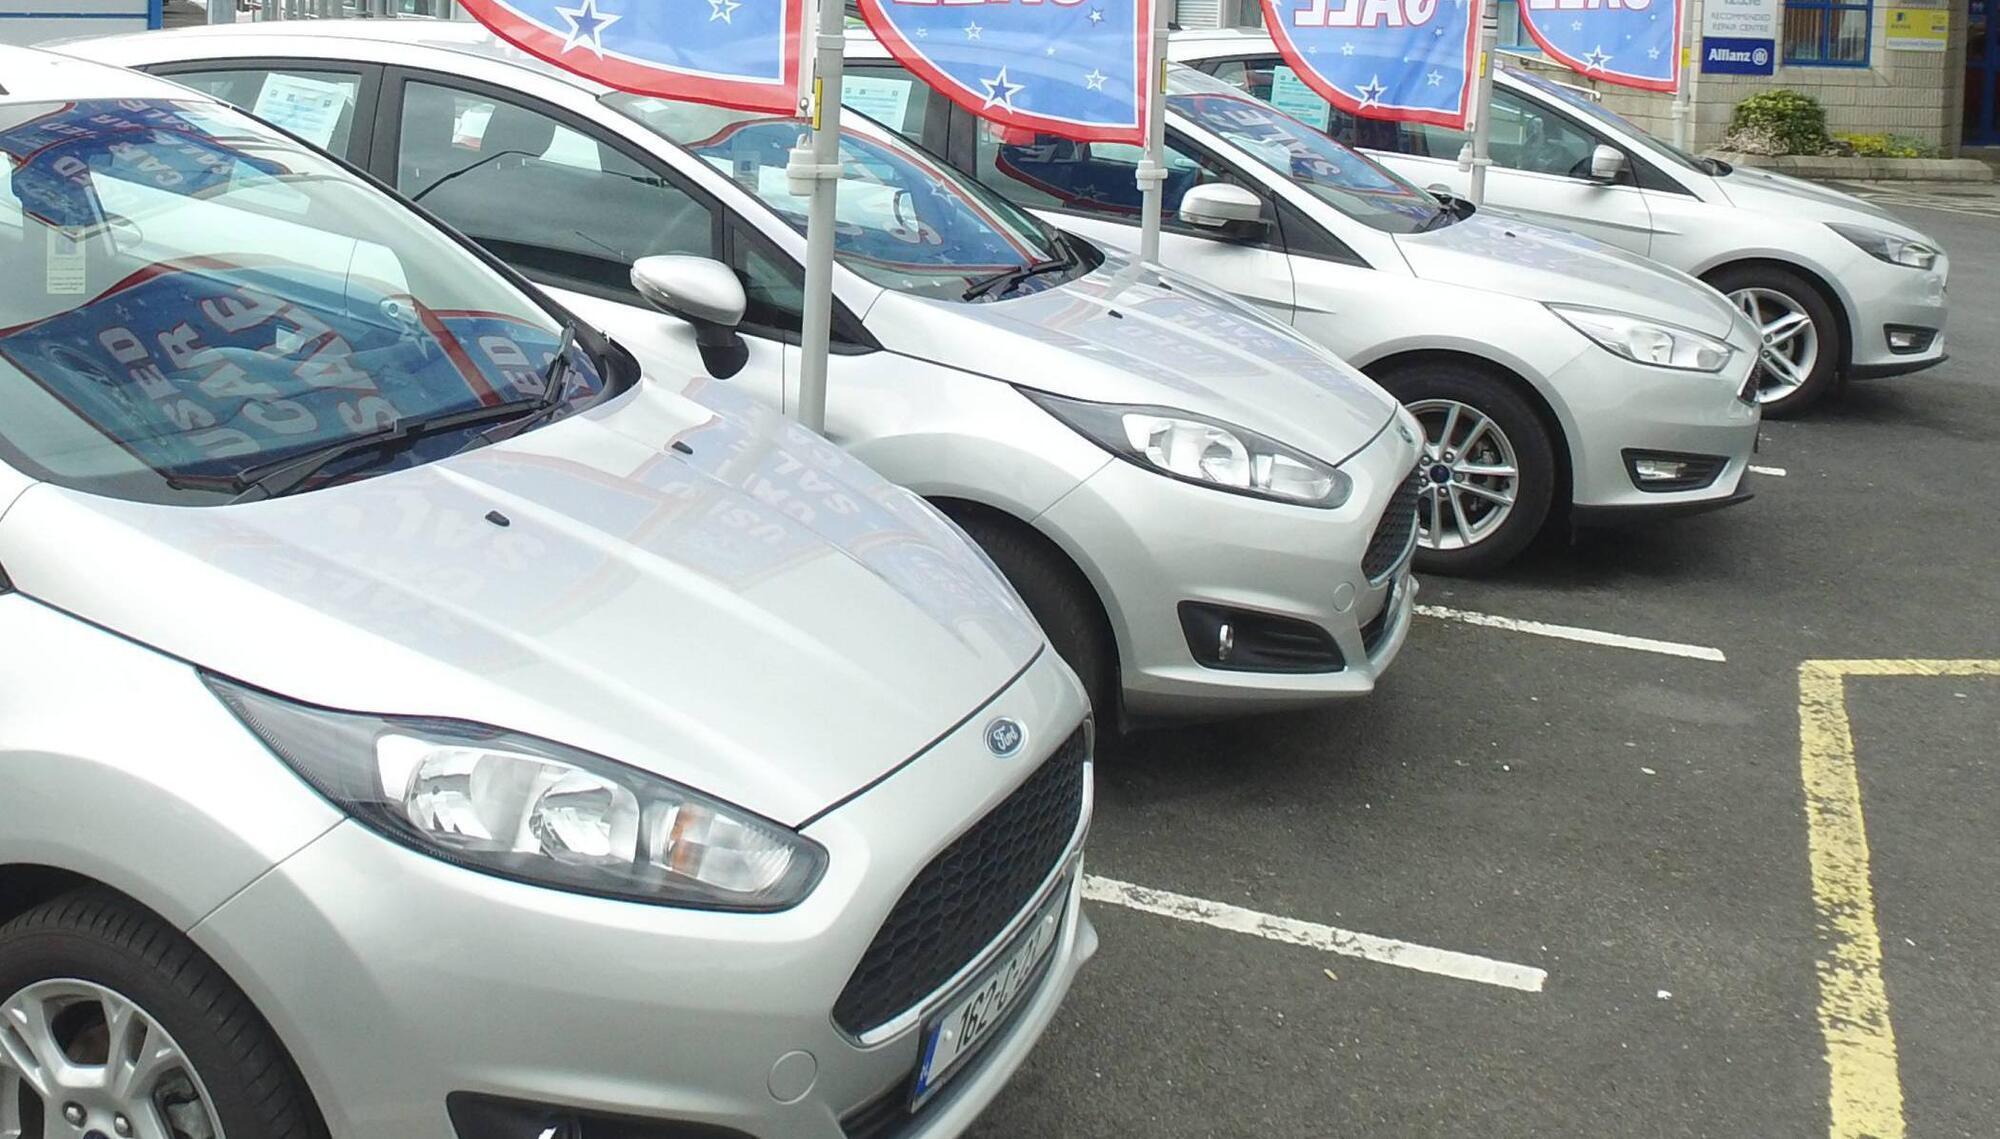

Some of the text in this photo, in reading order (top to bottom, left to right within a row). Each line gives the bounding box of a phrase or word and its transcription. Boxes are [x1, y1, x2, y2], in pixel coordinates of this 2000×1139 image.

[1708, 48, 1751, 62] Allianz
[98, 325, 263, 458] USED
[992, 724, 1019, 751] Ford
